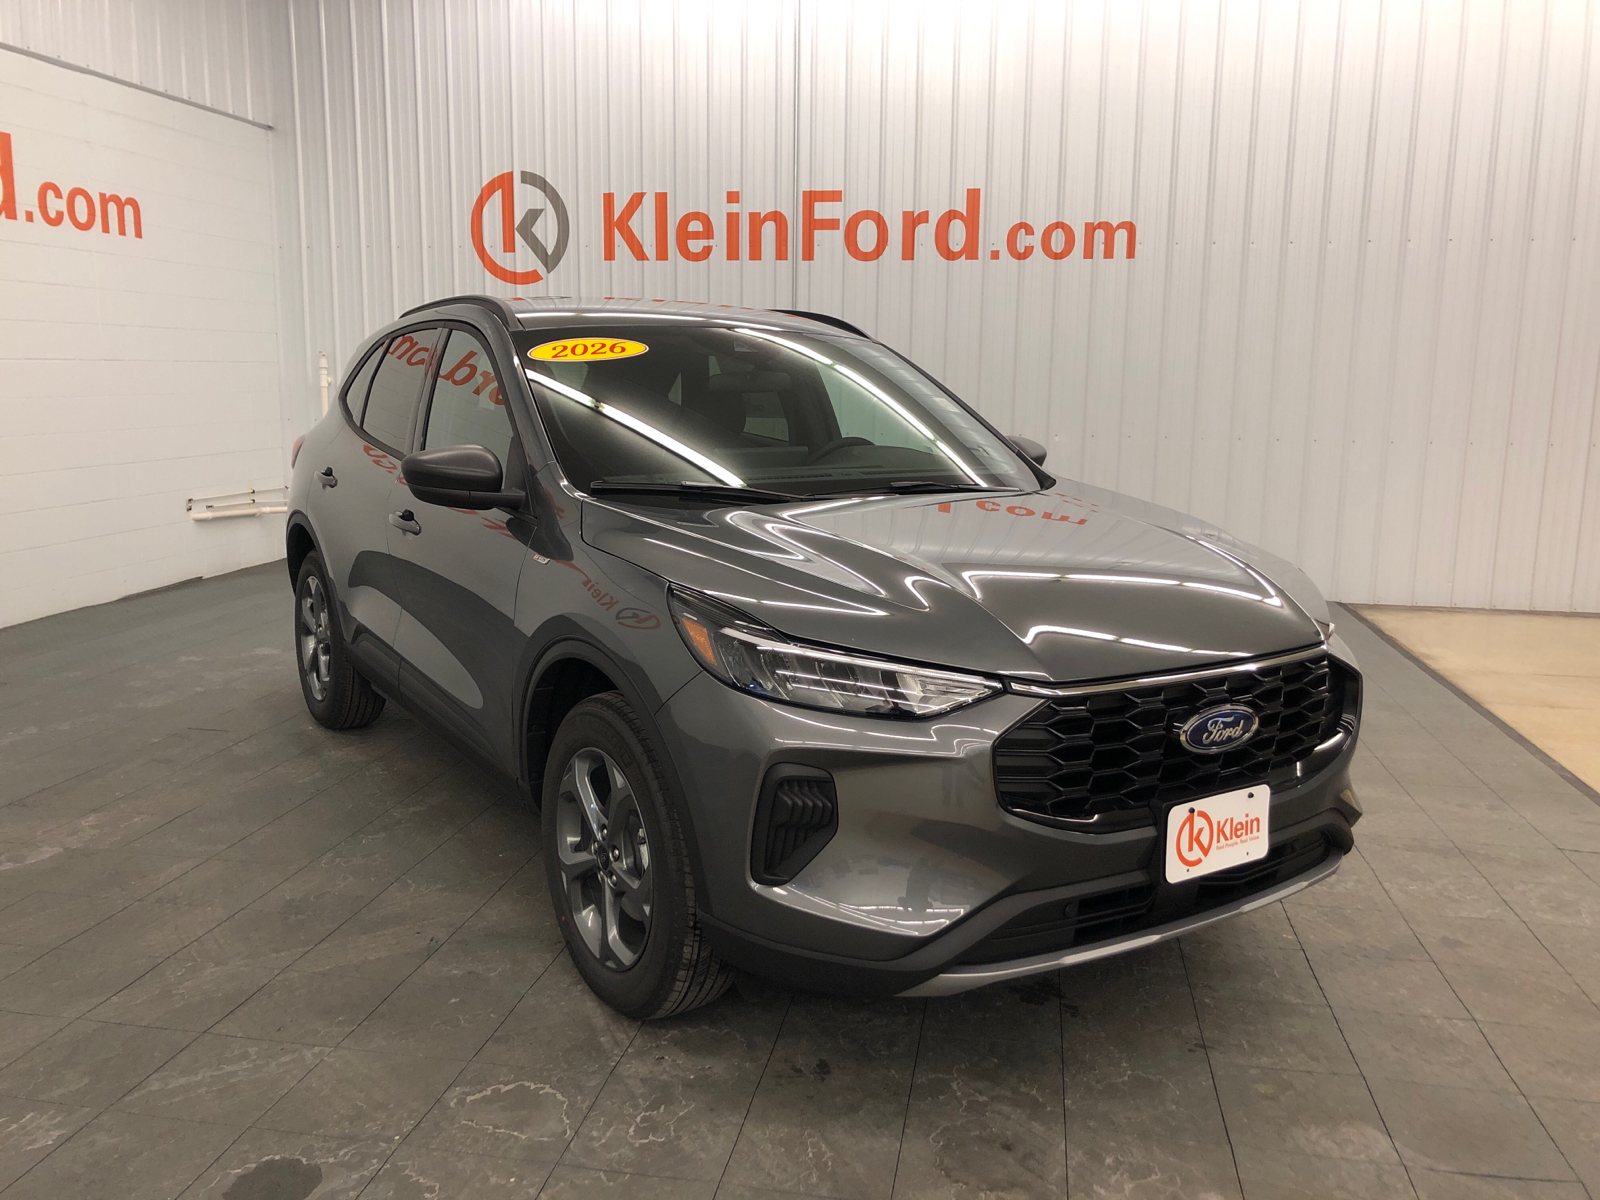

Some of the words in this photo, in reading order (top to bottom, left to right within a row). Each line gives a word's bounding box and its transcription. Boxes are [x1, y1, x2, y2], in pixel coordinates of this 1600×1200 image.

[603, 188, 1137, 263] KleinFord.com
[551, 341, 627, 359] 2026
[1202, 714, 1244, 744] Ford
[1216, 813, 1260, 844] Klein
